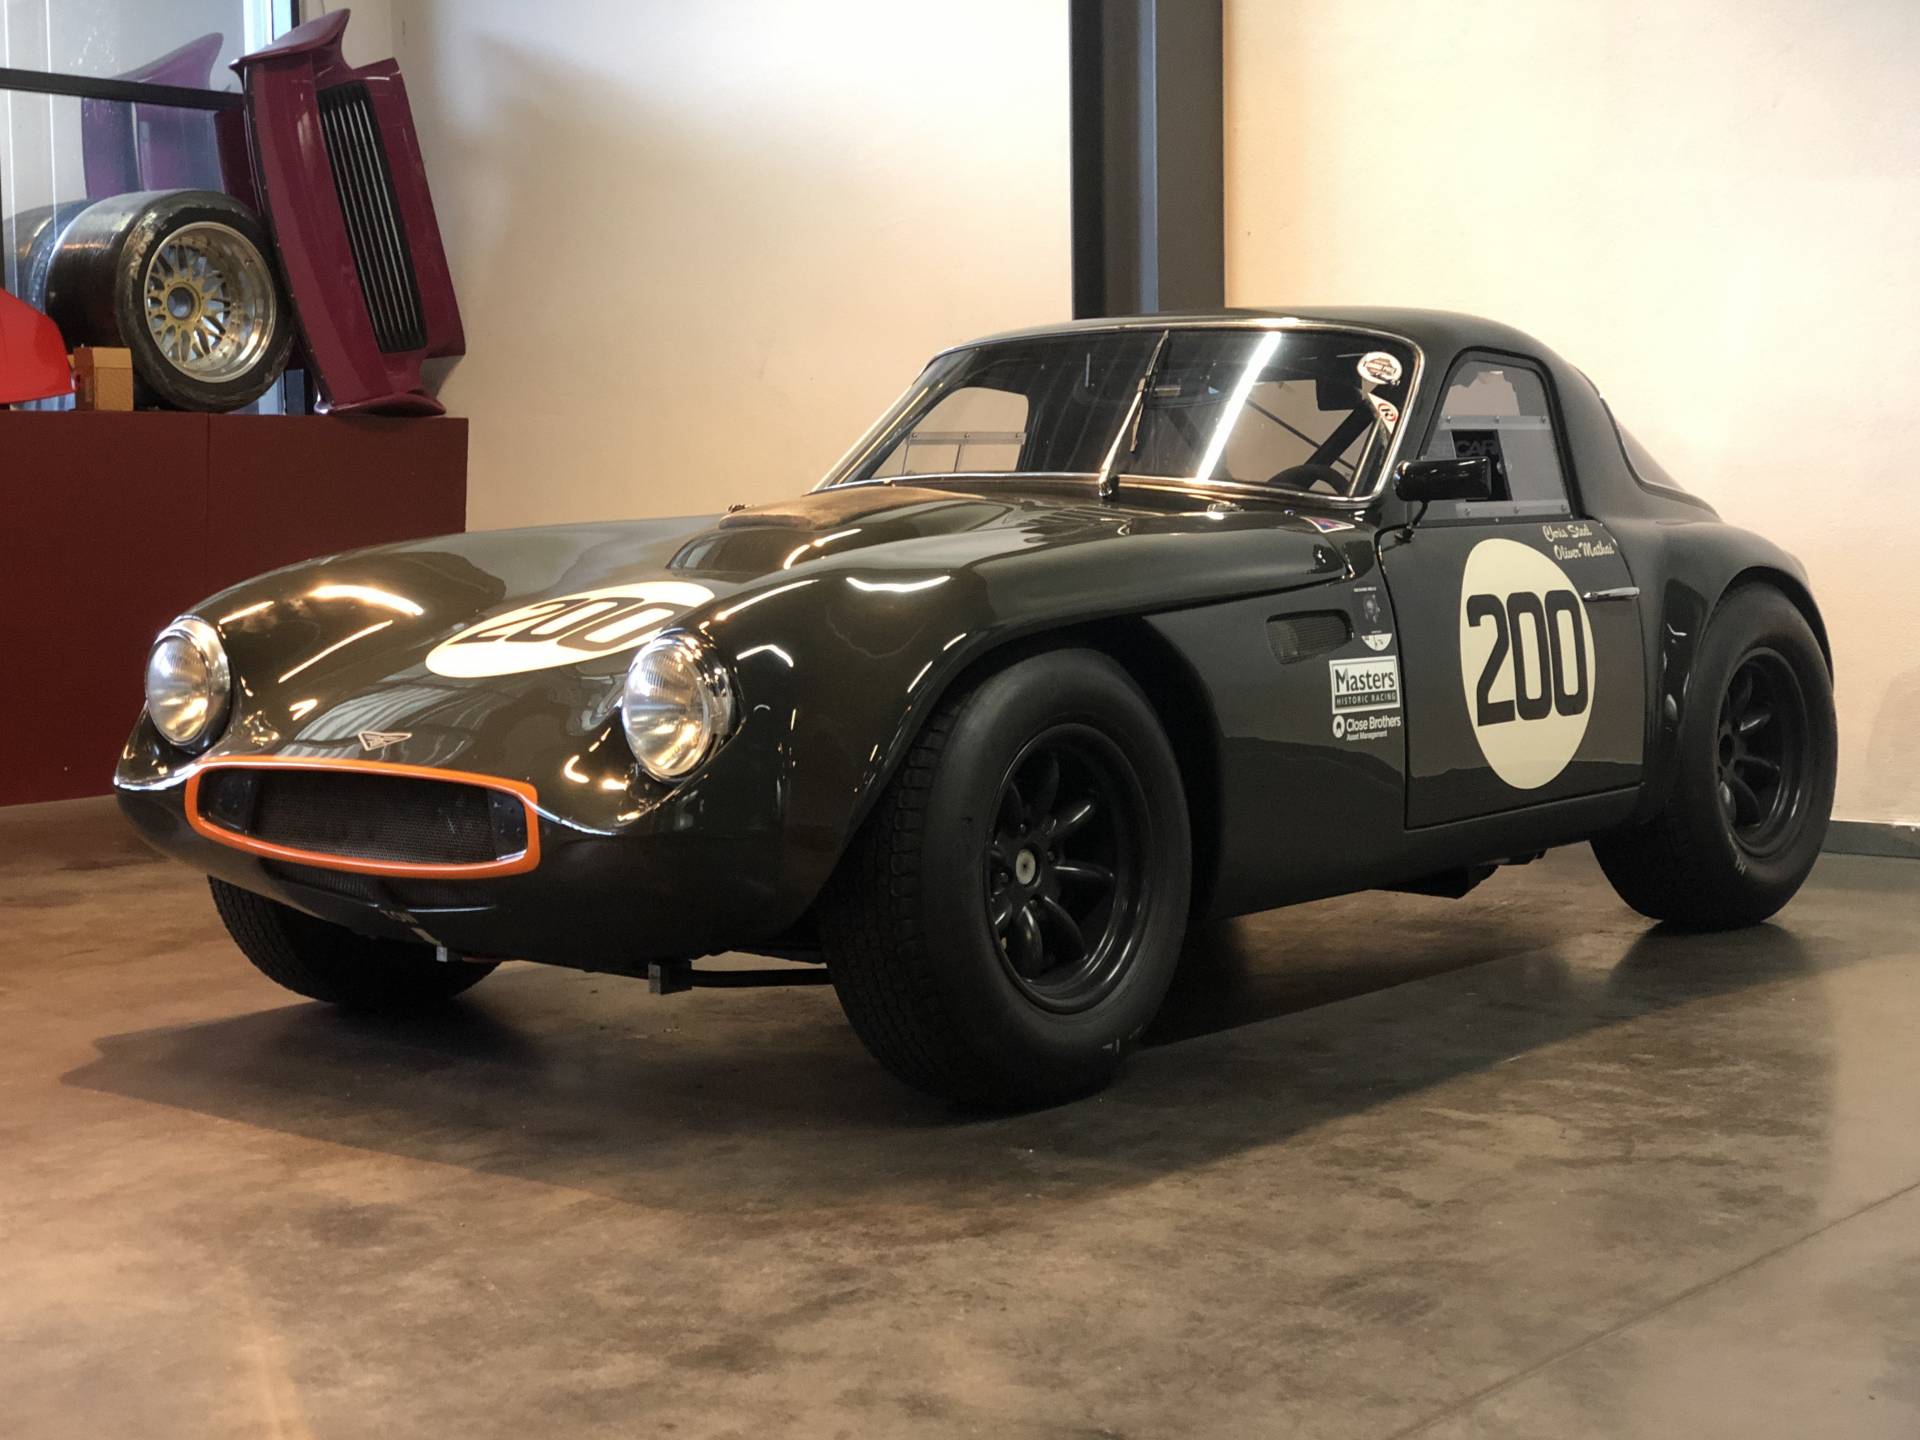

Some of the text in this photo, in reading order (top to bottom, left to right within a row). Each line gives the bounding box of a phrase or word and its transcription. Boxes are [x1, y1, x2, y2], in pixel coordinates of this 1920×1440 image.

[449, 597, 697, 652] 200
[1466, 589, 1588, 727] 200
[1335, 668, 1395, 693] Masters
[1336, 691, 1396, 705] HISTORIC RACING
[1346, 715, 1401, 732] Close Brothers
